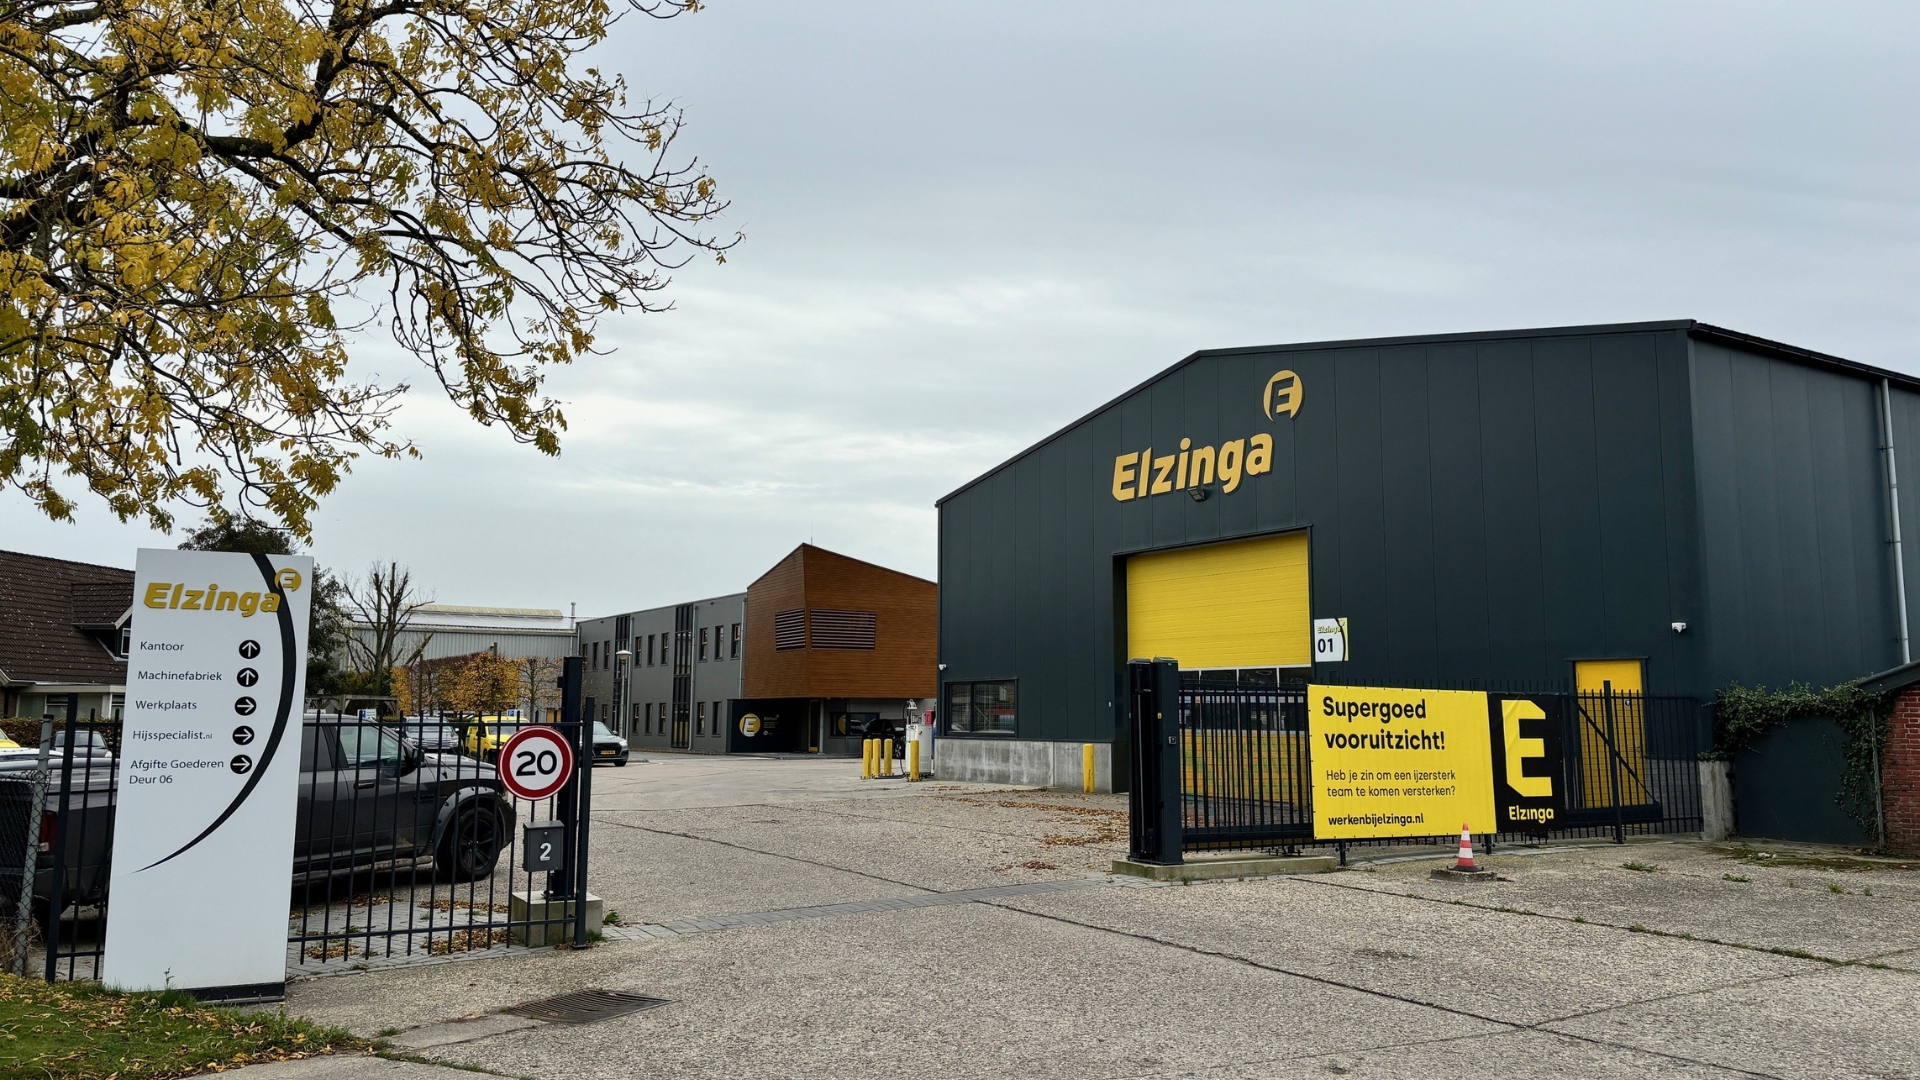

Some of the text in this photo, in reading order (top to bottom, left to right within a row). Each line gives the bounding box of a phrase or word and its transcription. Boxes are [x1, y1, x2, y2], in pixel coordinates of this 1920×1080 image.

[1112, 433, 1274, 502] Elzinga
[143, 582, 281, 618] Elzinga
[140, 641, 185, 651] Kantoor
[1317, 637, 1334, 654] 01
[137, 670, 223, 681] Machinefabriek
[135, 700, 198, 712] Werkplaats
[1322, 696, 1427, 724] Supergoed
[132, 730, 213, 742] Hijsspecialist.nl
[1324, 728, 1446, 750] vooruitzicht!
[1501, 699, 1553, 797] E
[130, 758, 224, 772] Afgifte Goederen
[516, 750, 558, 777] 20
[129, 774, 173, 785] Deur 06
[1326, 769, 1456, 783] Heb je zin om een ijzersterk
[1327, 785, 1456, 797] team te komen versterken?
[1328, 813, 1424, 827] werkenbijelzinga.nl
[1508, 804, 1554, 824] Elzinga
[539, 842, 552, 862] 2
